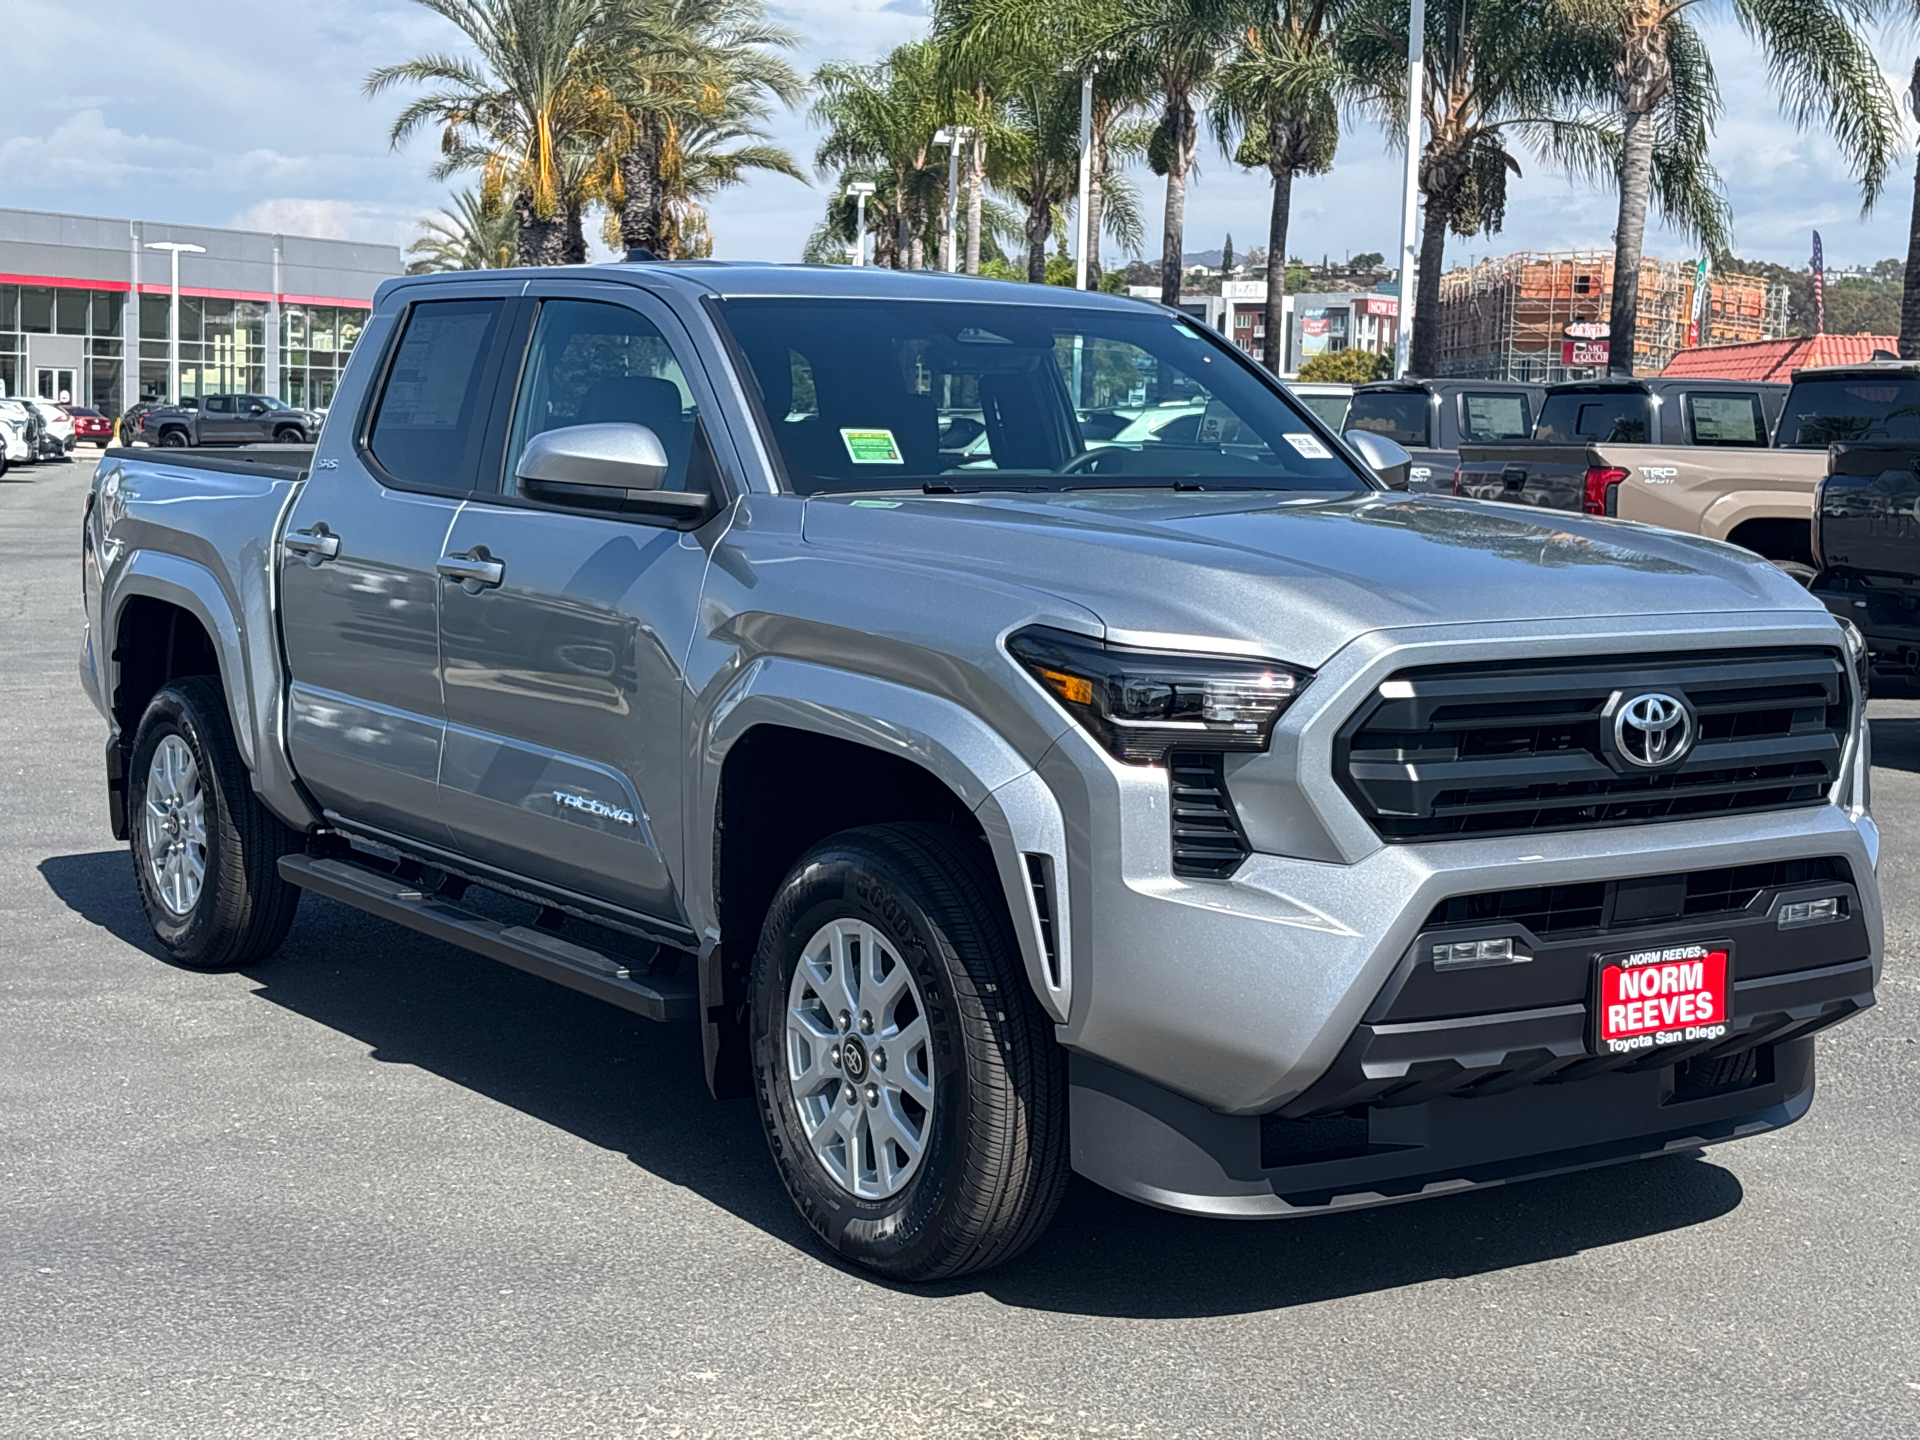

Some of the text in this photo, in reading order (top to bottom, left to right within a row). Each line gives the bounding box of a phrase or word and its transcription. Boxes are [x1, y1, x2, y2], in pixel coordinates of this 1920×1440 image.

[1371, 301, 1398, 316] NOW LE
[1410, 467, 1431, 478] RD
[1637, 466, 1679, 478] TRD
[553, 790, 635, 825] TACOMA
[1628, 946, 1702, 966] NORM REEVES
[1619, 962, 1703, 1001] NORM
[1608, 991, 1714, 1033] REEVES
[1606, 1025, 1726, 1053] Toyota San Diego
